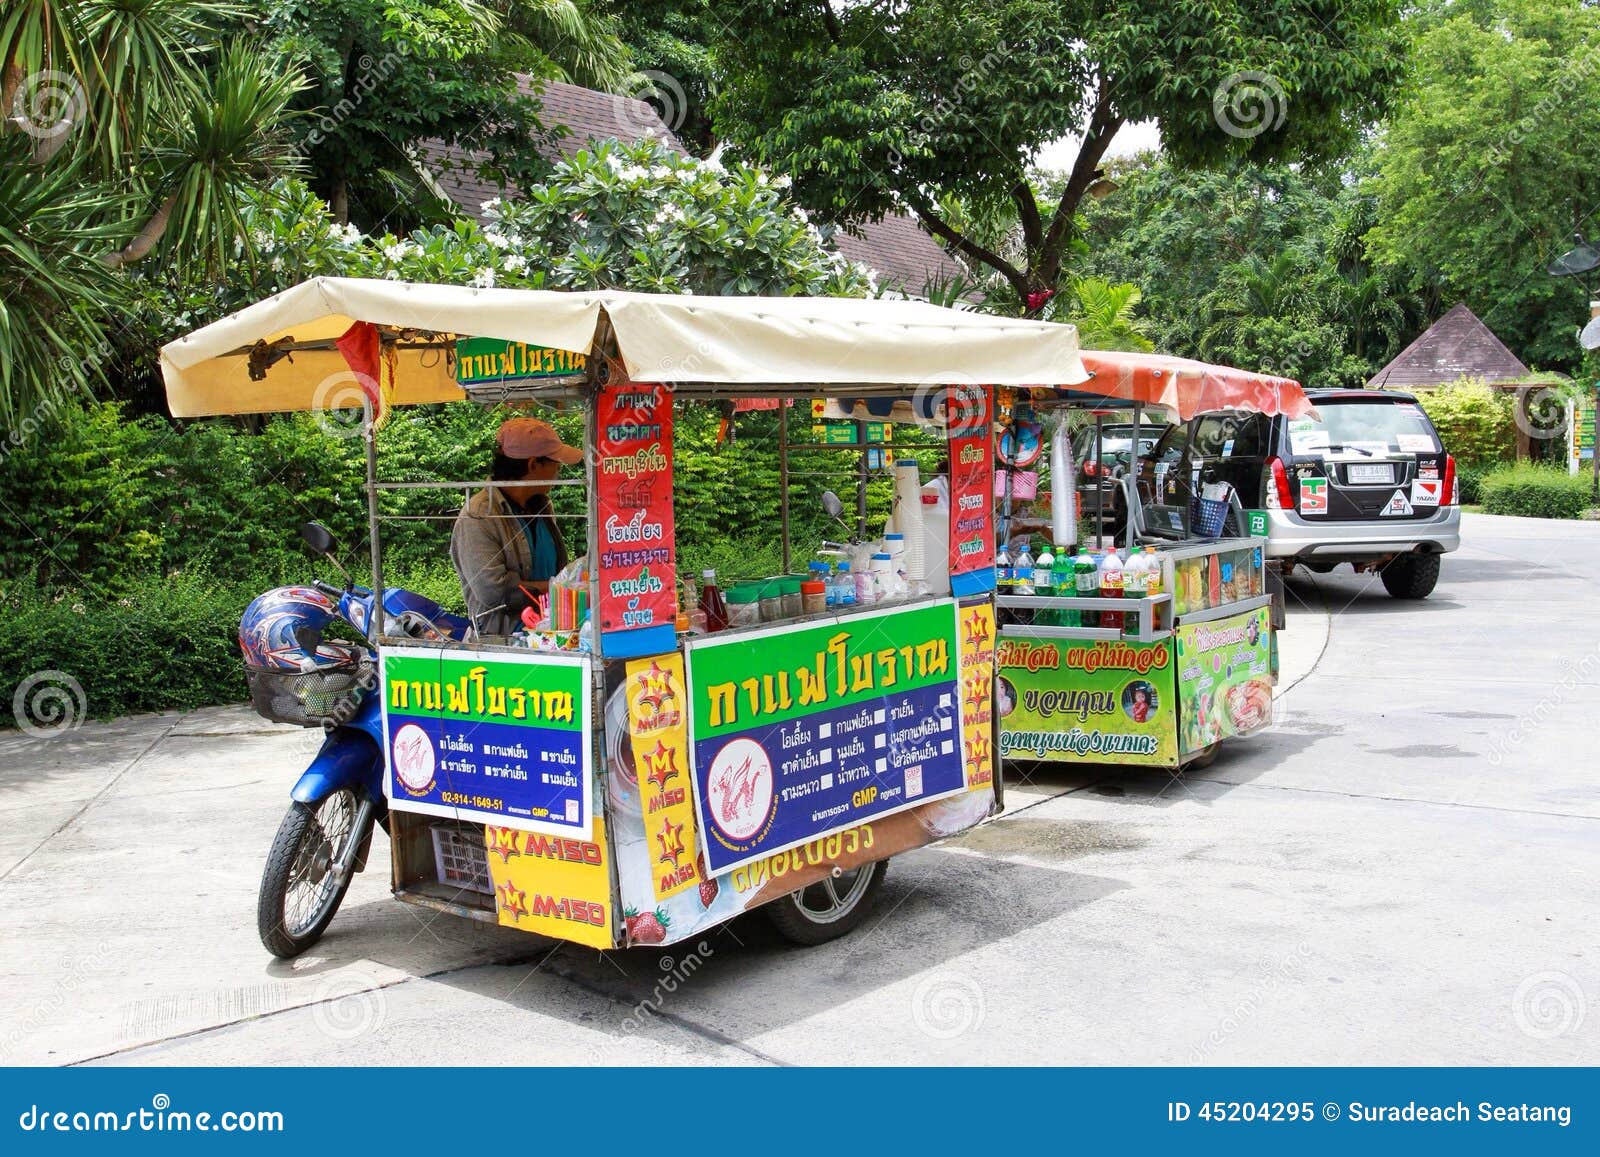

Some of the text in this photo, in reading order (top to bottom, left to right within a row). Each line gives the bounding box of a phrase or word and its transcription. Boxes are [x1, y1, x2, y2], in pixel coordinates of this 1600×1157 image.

[390, 666, 575, 724] กาแฟโบราณ
[707, 631, 950, 727] กาแฟโบราณ
[836, 712, 873, 736] กาแฟเย็น
[890, 699, 914, 721] ชาเย็น
[1025, 689, 1115, 722] ขอบคุณ
[491, 743, 529, 760] กาแฟเย็น
[549, 748, 576, 765] ชาเย็น
[836, 738, 865, 760] นมเย็น
[441, 791, 503, 811] 02-814-1649-51
[532, 807, 549, 818] GMP
[852, 786, 878, 808] GMP
[525, 833, 603, 867] M-150
[532, 893, 605, 927] M-150
